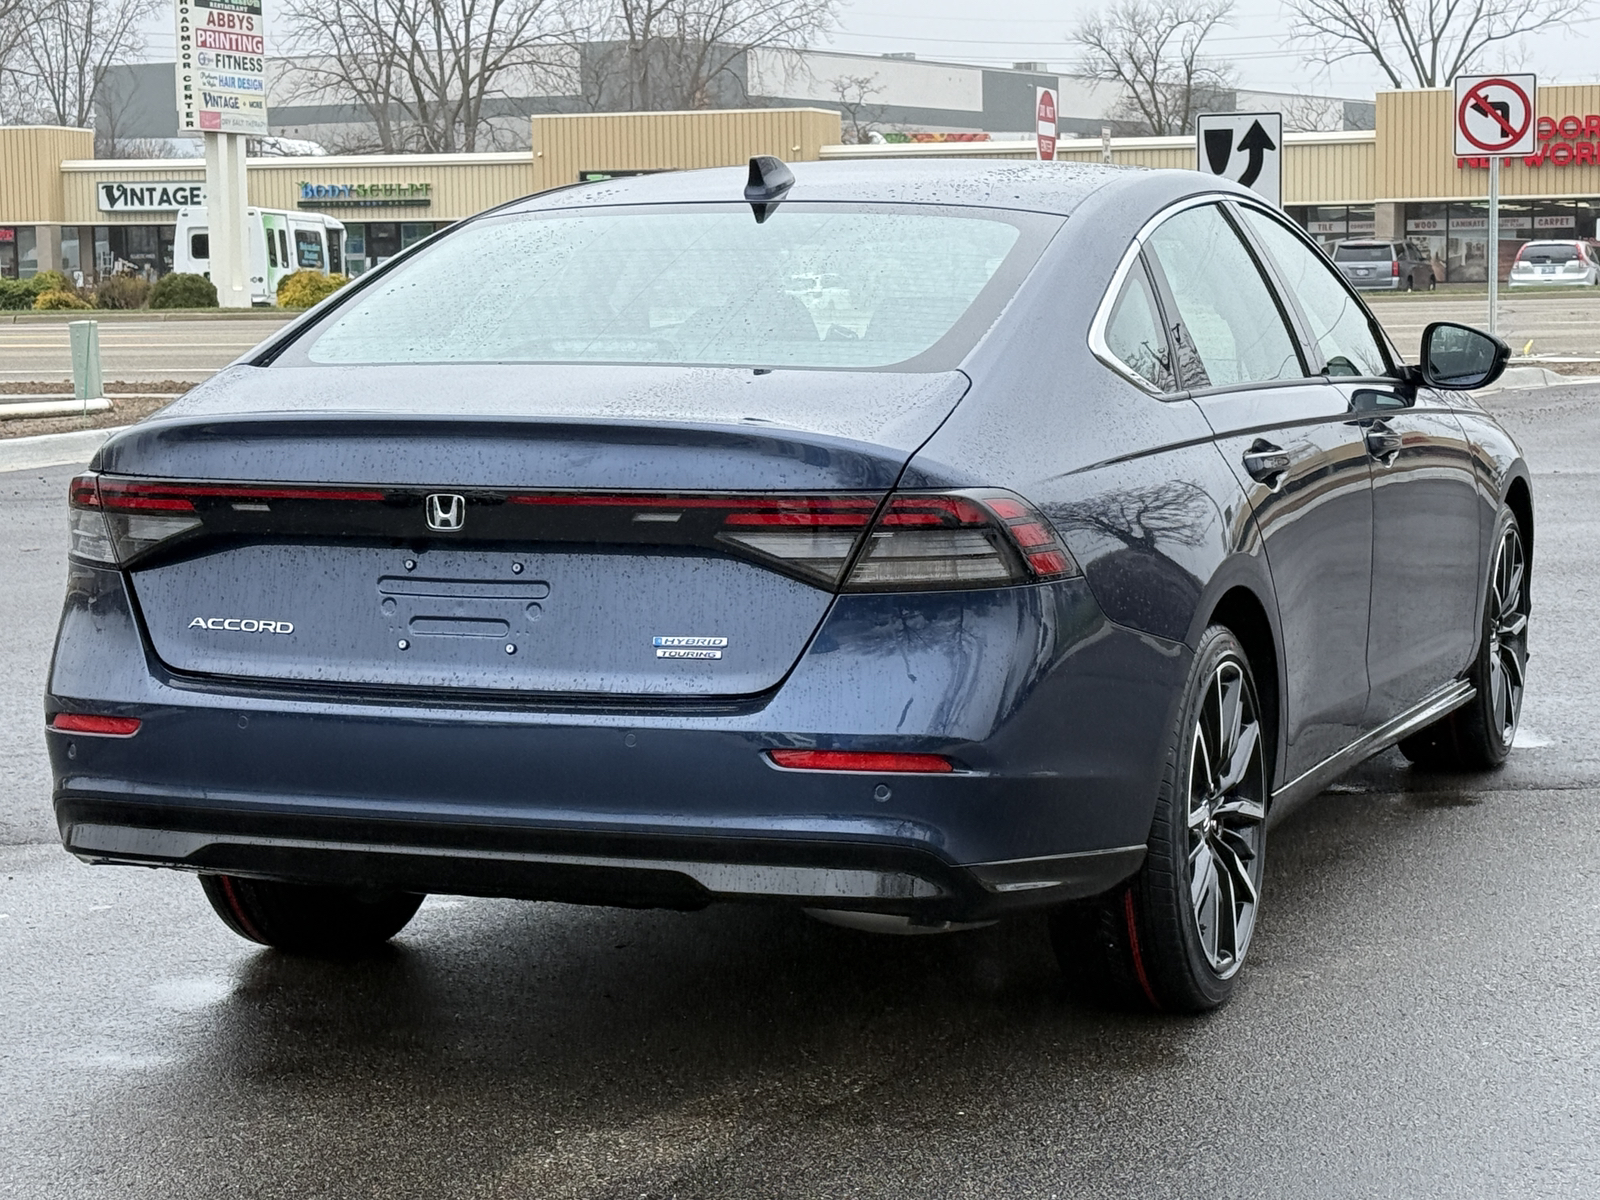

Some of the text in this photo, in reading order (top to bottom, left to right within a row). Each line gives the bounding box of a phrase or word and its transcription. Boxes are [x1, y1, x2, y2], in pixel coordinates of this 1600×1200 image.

[209, 2, 248, 13] RESTAURANT
[206, 11, 254, 32] ABBYS
[196, 29, 263, 54] PRINTING
[215, 53, 263, 73] FITNESS
[218, 75, 236, 89] HAIR
[237, 77, 263, 91] DESIGN
[183, 75, 194, 127] CENTER
[202, 92, 240, 110] VINTAGE
[101, 184, 202, 209] VINTAGE
[301, 183, 431, 199] BODY SCULPT
[1318, 223, 1334, 232] TILE
[1414, 221, 1437, 229] WOOD
[1451, 220, 1485, 228] LAMINATE
[1538, 218, 1570, 226] CARPET
[187, 617, 294, 634] ACCORD
[664, 637, 724, 646] HYBRID
[660, 650, 718, 658] TOURING
